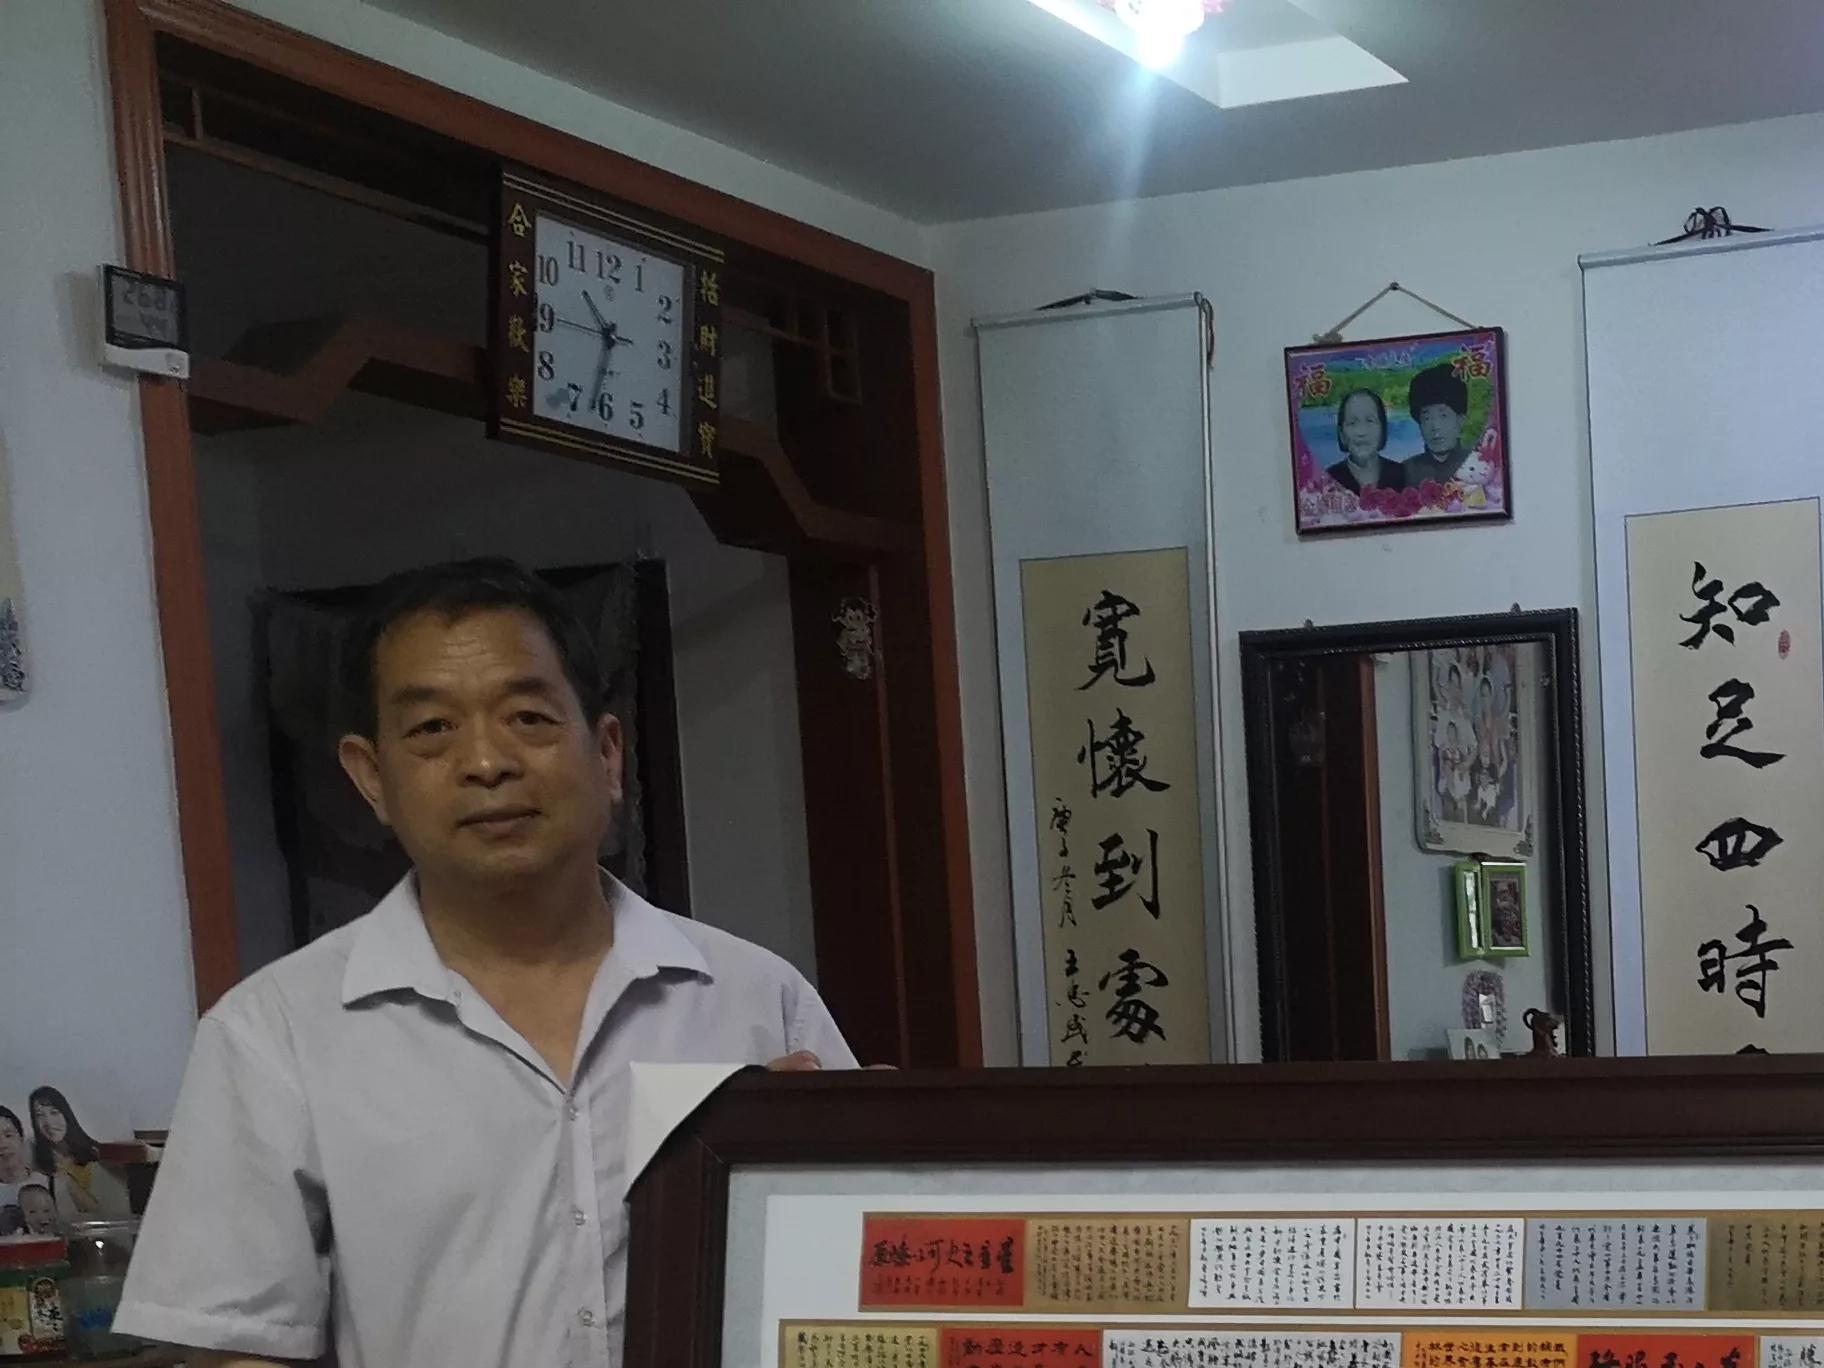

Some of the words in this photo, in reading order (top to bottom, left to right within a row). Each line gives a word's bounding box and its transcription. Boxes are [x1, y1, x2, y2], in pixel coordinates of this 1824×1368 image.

[537, 254, 560, 287] 10
[567, 240, 586, 273] 11
[596, 251, 621, 285] 12
[635, 264, 644, 293] 1
[539, 303, 555, 334] 9
[657, 294, 672, 326] 2
[538, 351, 555, 382] 8
[657, 340, 672, 370] 3
[1451, 344, 1494, 383] 福
[1294, 363, 1332, 399] 福
[567, 383, 584, 413] 7
[599, 392, 614, 422] 6
[656, 388, 671, 416] 4
[629, 401, 645, 431] 5
[1677, 561, 1794, 1055] 知足四時
